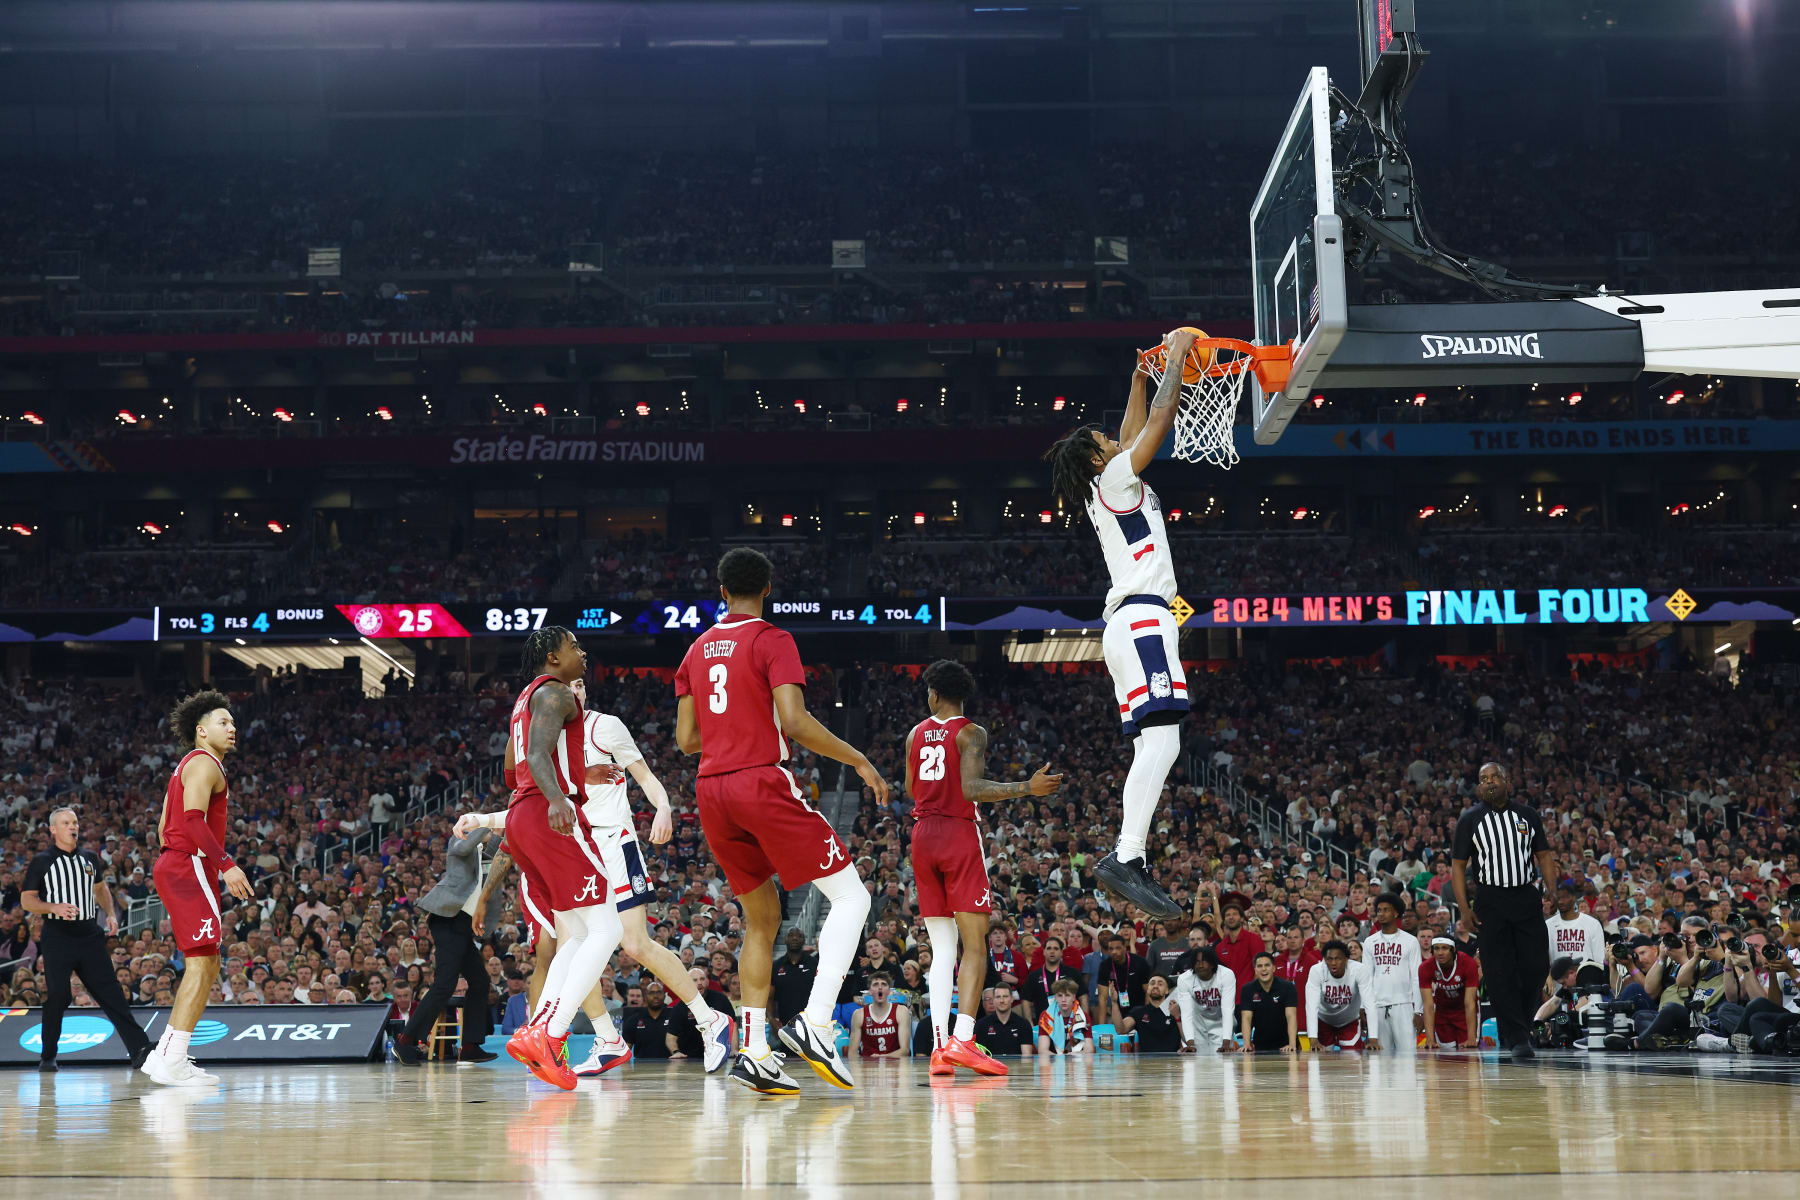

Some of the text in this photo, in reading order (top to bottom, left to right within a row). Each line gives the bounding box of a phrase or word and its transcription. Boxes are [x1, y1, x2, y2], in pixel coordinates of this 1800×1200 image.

[346, 332, 383, 345] PAT
[388, 331, 475, 345] TILLMAN
[1420, 332, 1544, 359] SPALDING
[1469, 426, 1751, 450] THE ROAD ENDS HERE
[602, 442, 705, 462] STADIUM
[276, 608, 324, 620] BONUS
[582, 608, 604, 618] 1ST
[773, 602, 820, 614] BONUS
[832, 604, 932, 625] FLS 4 TOL 4
[1213, 588, 1651, 625] 2024 MEN'S FINAL FOUR
[170, 612, 270, 633] TOL 3 FLS 4
[398, 610, 433, 632] 25
[485, 608, 548, 631] 8:37
[577, 618, 608, 629] HALF
[664, 606, 701, 628] 24
[709, 663, 728, 715] 3
[919, 744, 946, 781] 23
[1557, 929, 1585, 941] BAMA
[1374, 942, 1402, 956] BAMA
[1557, 942, 1585, 952] ENERGY
[1194, 988, 1222, 1000] BAMA
[1325, 984, 1352, 997] BAMA
[233, 1023, 352, 1041] AT&T
[877, 1037, 887, 1051] 2
